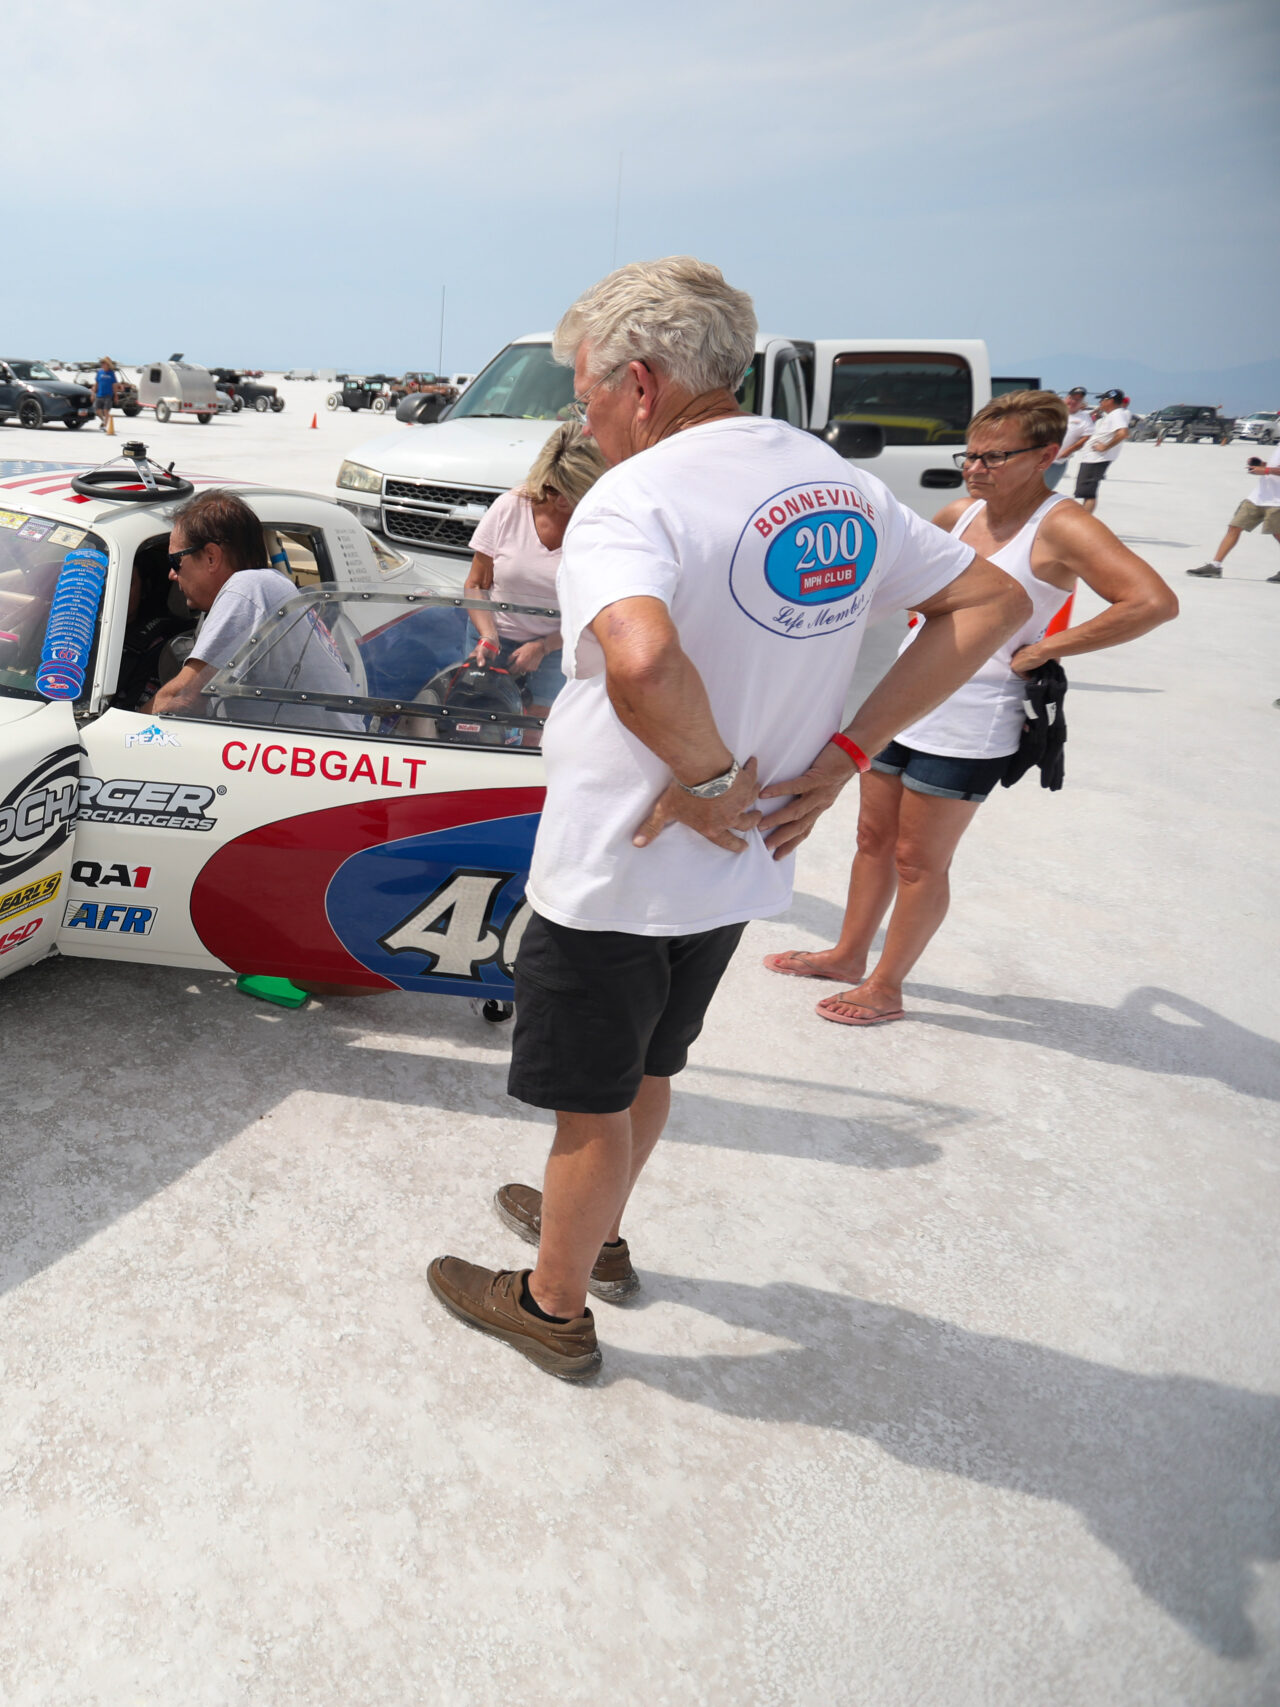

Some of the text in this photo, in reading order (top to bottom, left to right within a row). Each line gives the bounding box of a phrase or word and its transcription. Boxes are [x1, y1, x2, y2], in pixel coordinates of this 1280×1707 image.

[753, 488, 875, 538] BONNEVILLE
[795, 517, 863, 572] 200
[803, 568, 853, 588] MPH CLUB
[772, 592, 867, 633] Life Memb
[123, 731, 182, 749] PEAK
[221, 740, 427, 790] C/CBGALT
[70, 860, 153, 890] QA1
[68, 902, 153, 934] AFR
